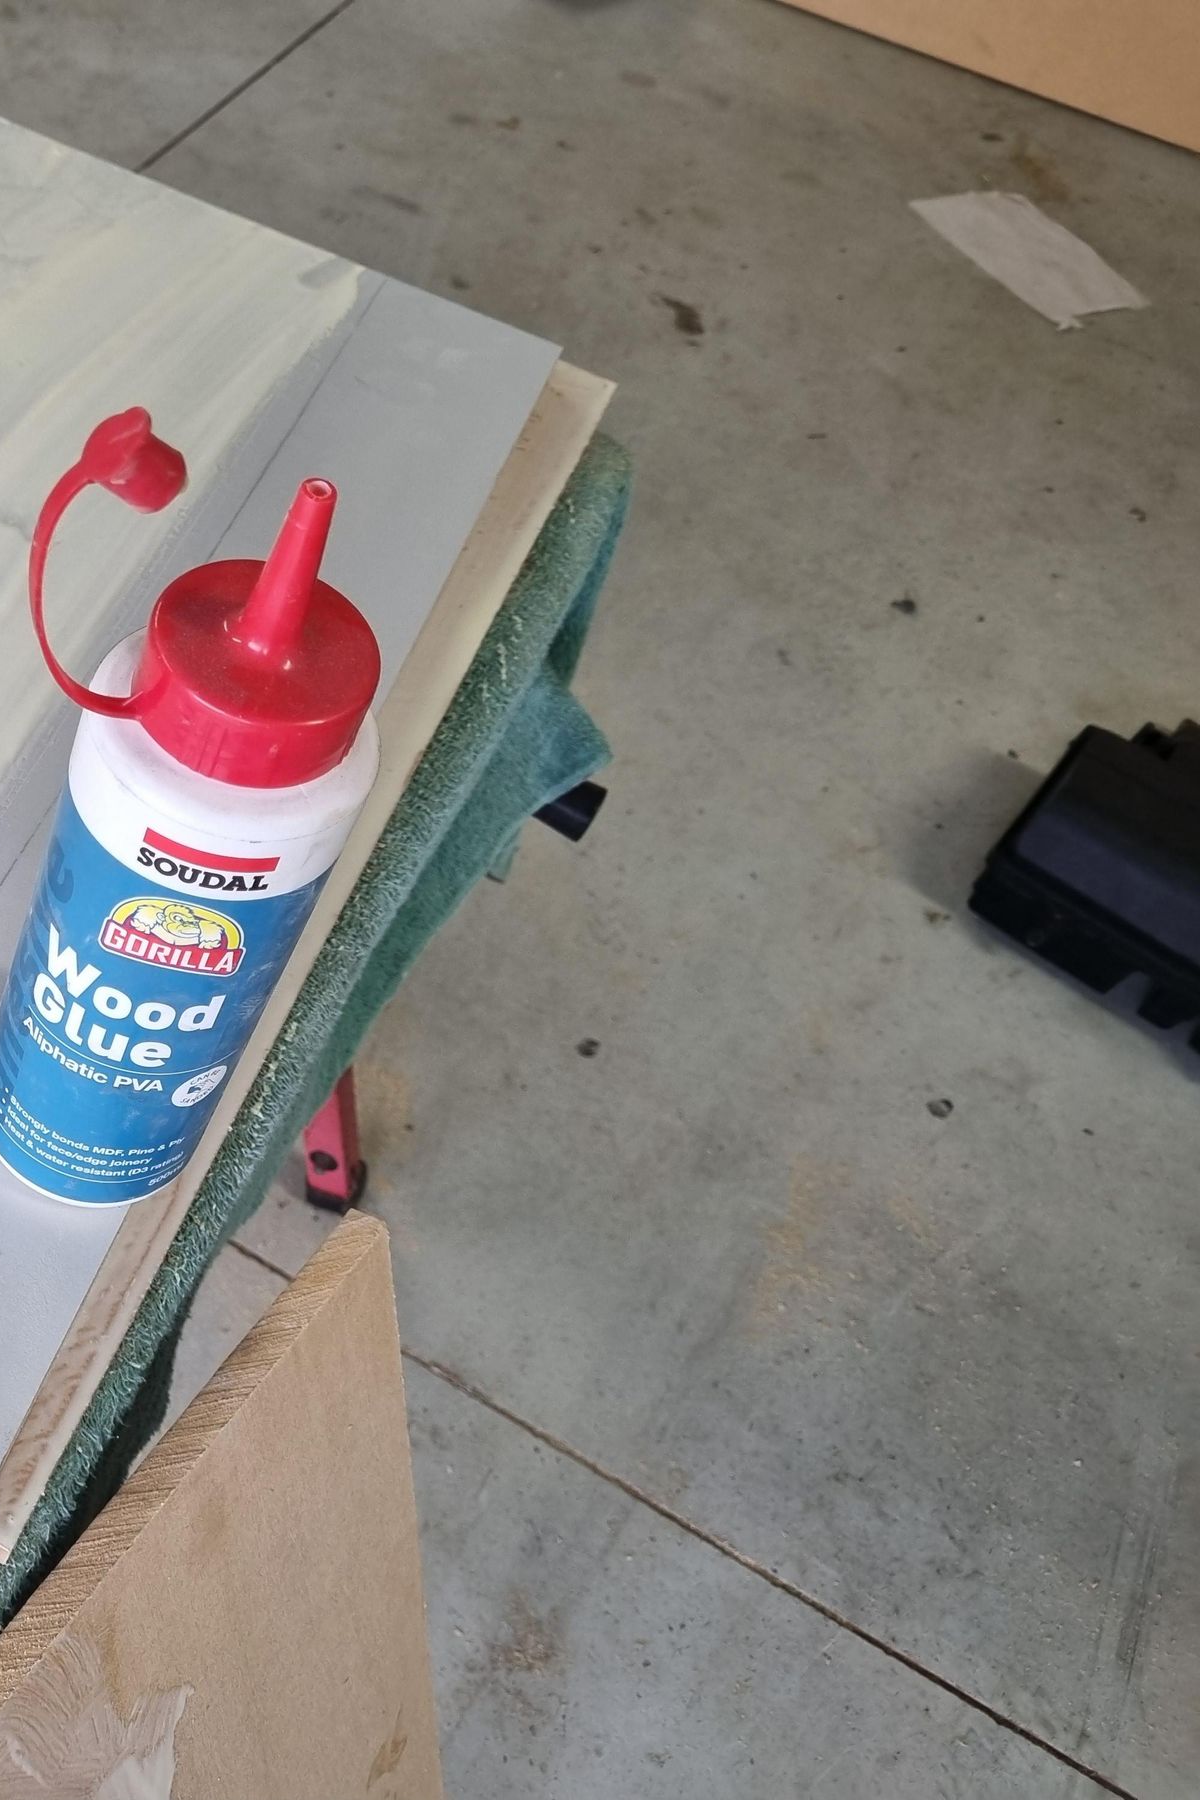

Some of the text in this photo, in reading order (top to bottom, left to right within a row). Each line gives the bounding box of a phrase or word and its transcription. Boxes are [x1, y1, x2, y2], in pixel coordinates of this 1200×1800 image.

[137, 847, 269, 891] SOUDAL
[47, 922, 227, 1032] Wood
[103, 923, 234, 973] GORILLA
[23, 1016, 108, 1084] Aliphatic
[33, 972, 172, 1068] Glue
[113, 1075, 163, 1092] PVA
[4, 1116, 26, 1142] Heat
[25, 1139, 34, 1150] &
[36, 1147, 69, 1167] water
[70, 1164, 126, 1177] resistant
[128, 1165, 149, 1177] (D3
[7, 1105, 153, 1167] Ideal for face/edge joinery
[10, 1095, 50, 1134] Strongly
[51, 1130, 90, 1151] bonds
[92, 1146, 125, 1157] MDF,
[128, 1148, 155, 1156] Pine
